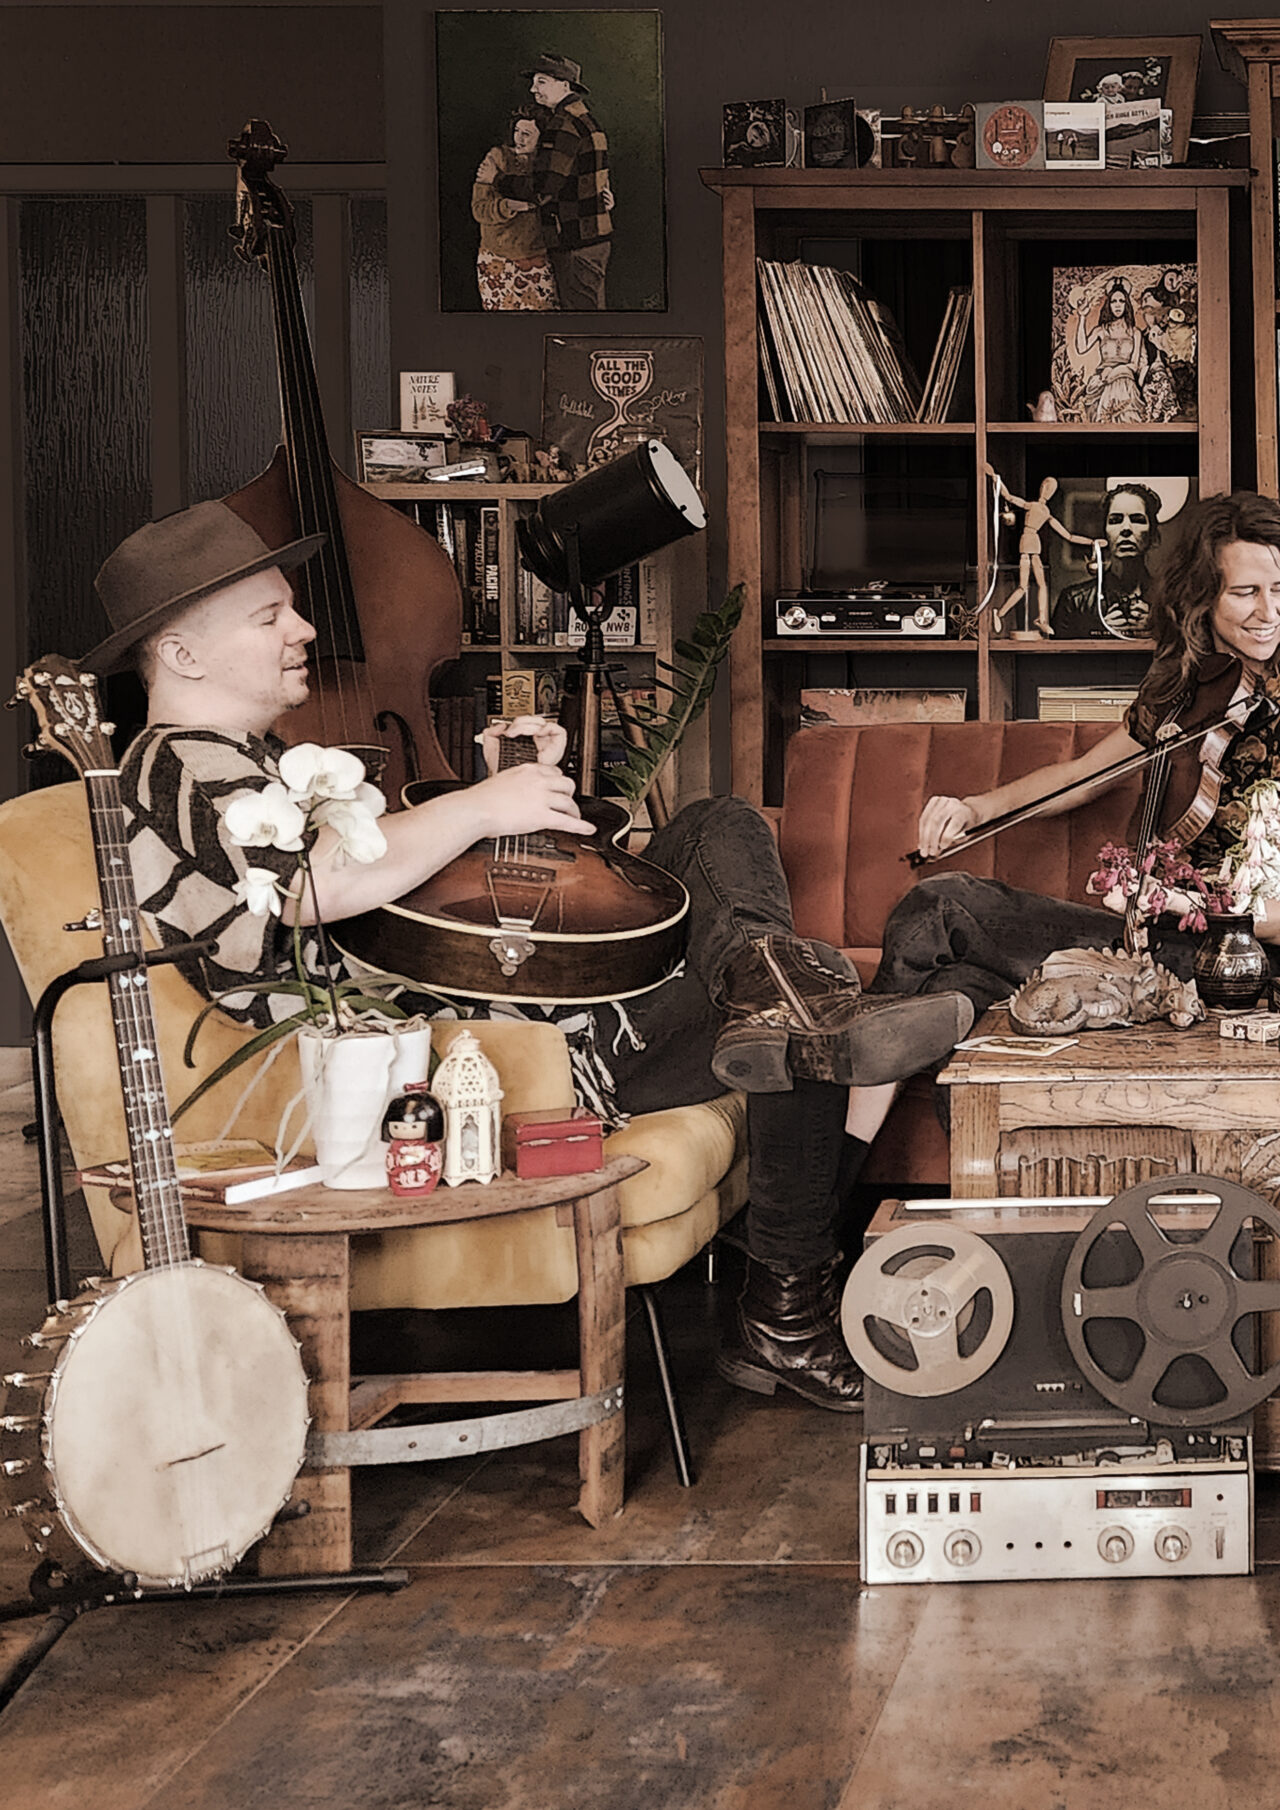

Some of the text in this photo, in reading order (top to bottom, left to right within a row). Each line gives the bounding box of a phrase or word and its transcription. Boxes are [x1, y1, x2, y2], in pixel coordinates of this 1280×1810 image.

[597, 360, 646, 371] ALL THE
[409, 375, 440, 384] NATURE
[601, 372, 643, 384] GOOD
[410, 385, 438, 394] NOTES
[605, 385, 637, 397] TIMES
[486, 564, 498, 600] PACIFIC
[606, 622, 630, 632] NW8
